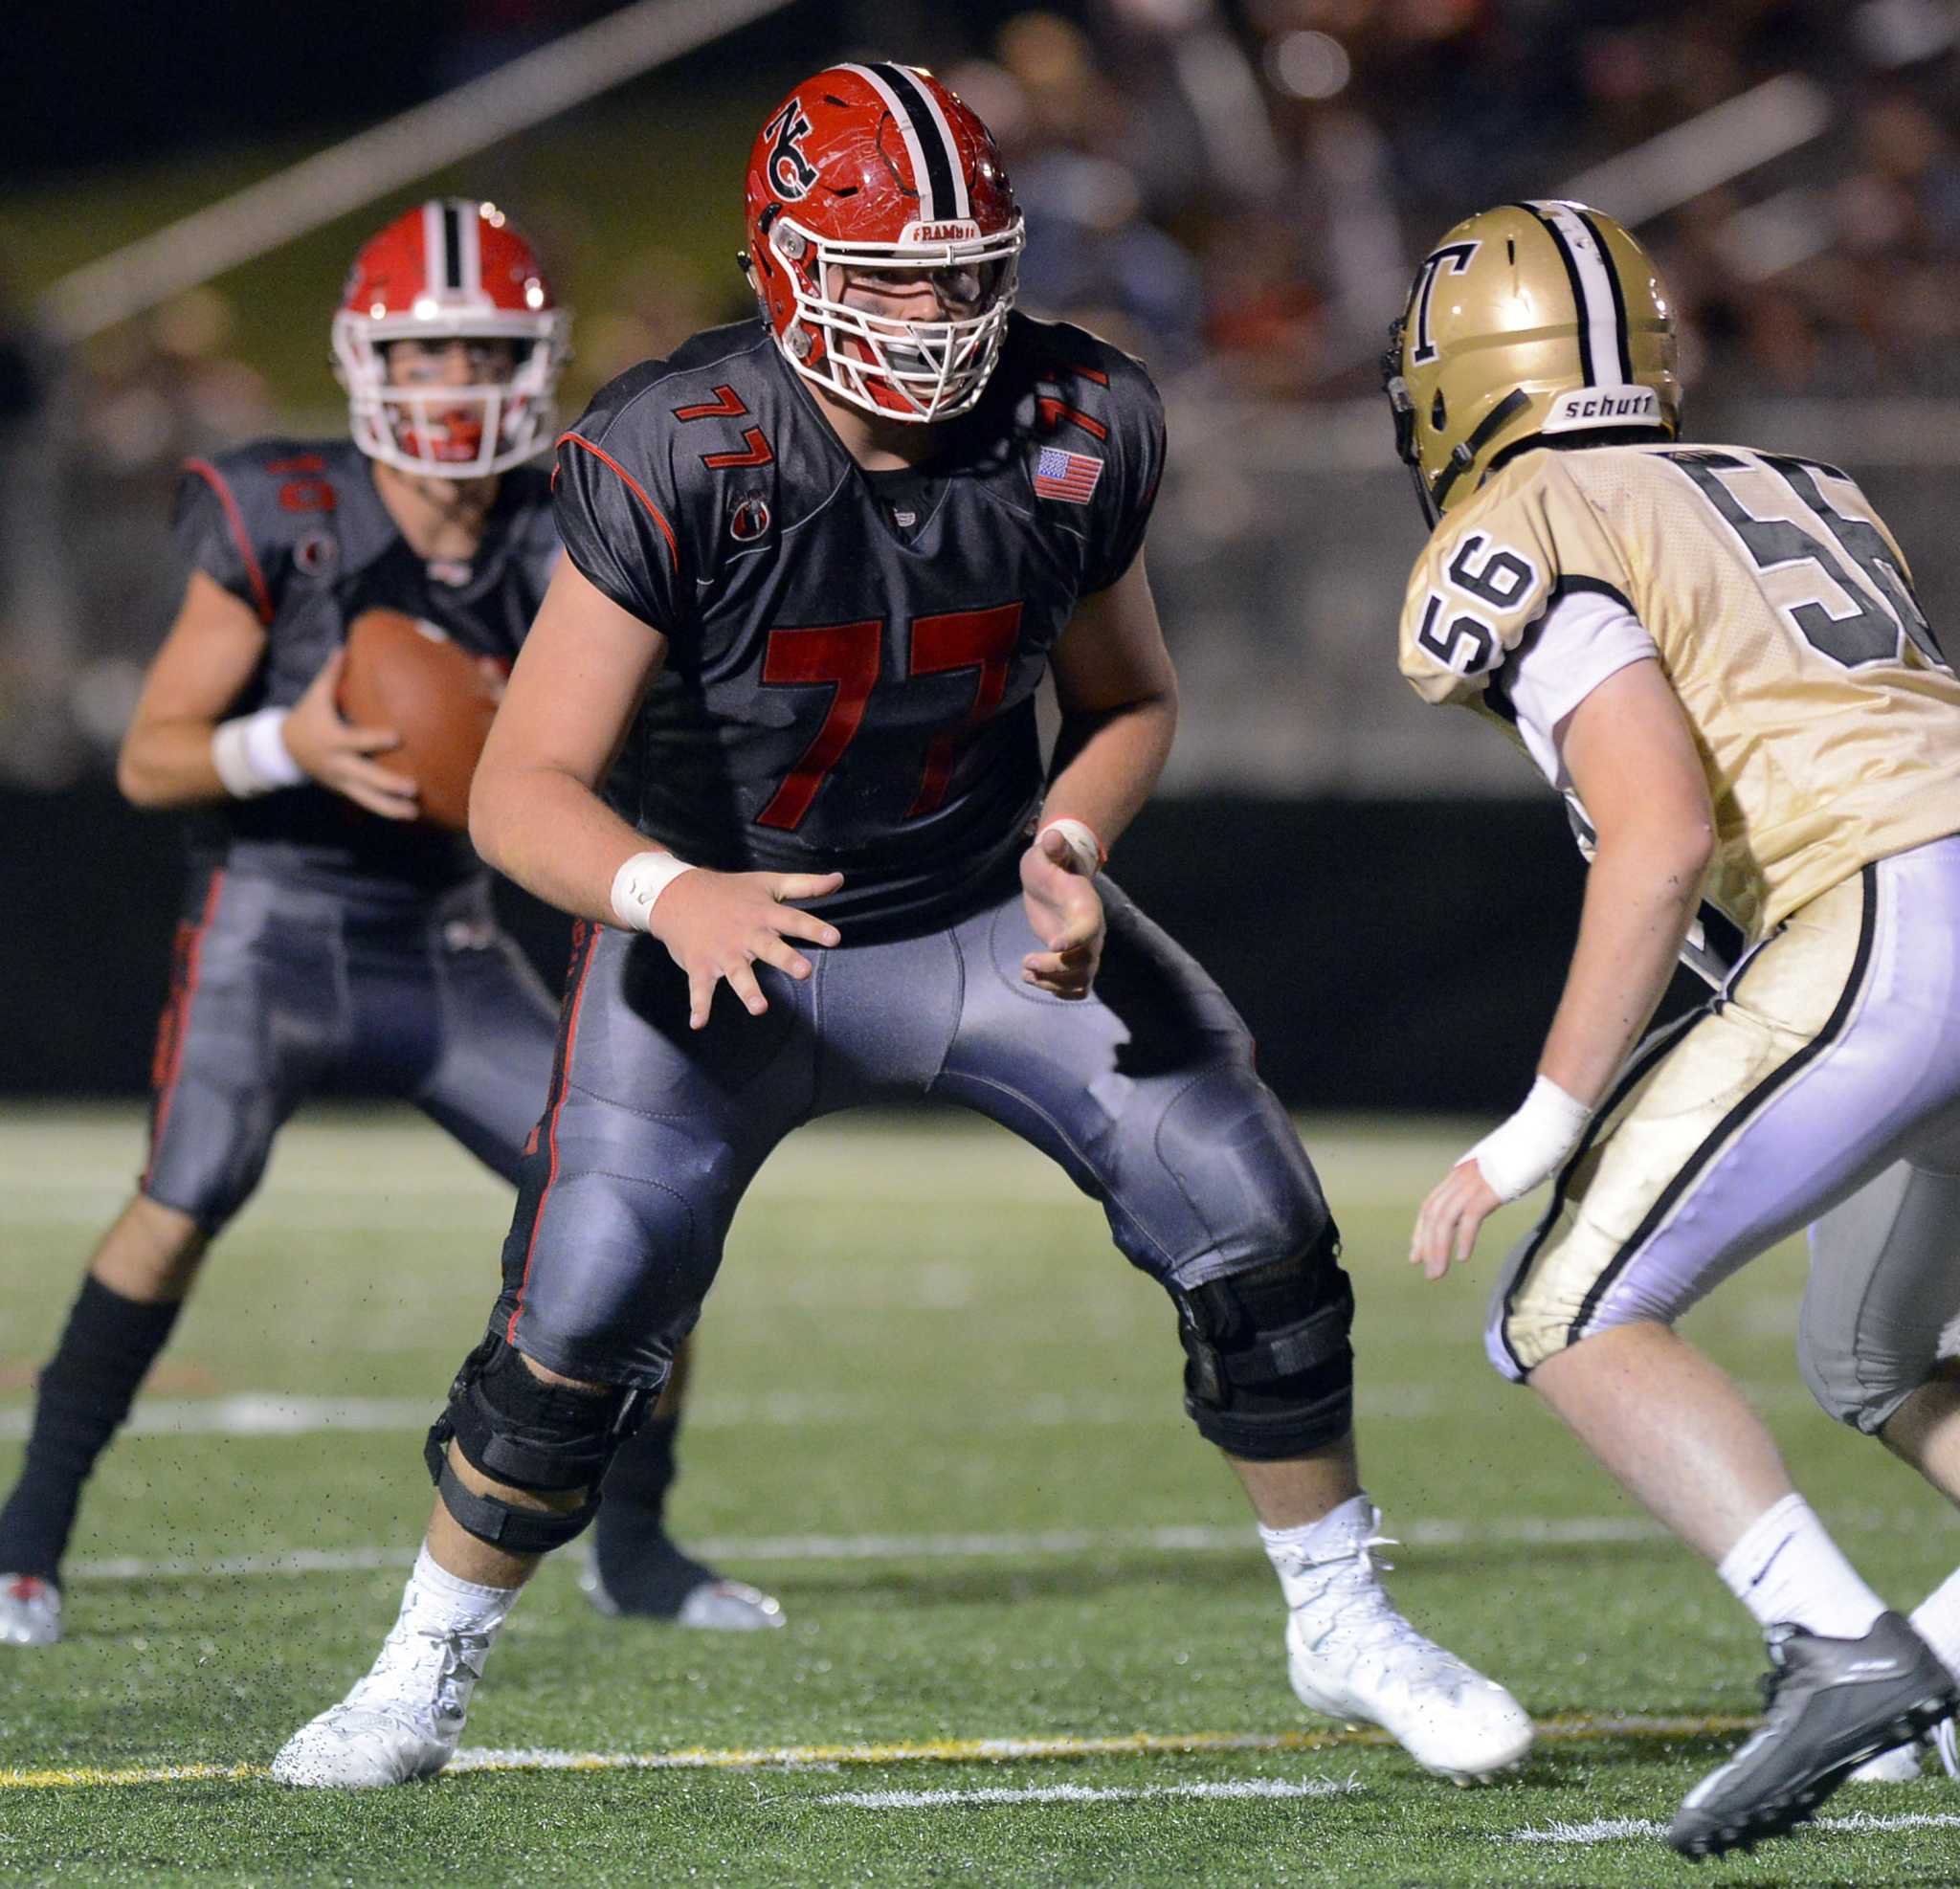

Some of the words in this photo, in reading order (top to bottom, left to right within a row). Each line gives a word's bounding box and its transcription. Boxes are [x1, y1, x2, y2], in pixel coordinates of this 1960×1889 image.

[1411, 240, 1482, 367] T
[671, 384, 774, 471] 77
[1565, 394, 1654, 418] schutt
[1414, 530, 1537, 676] 56
[1640, 451, 1949, 671] 56
[754, 599, 1025, 832] 77
